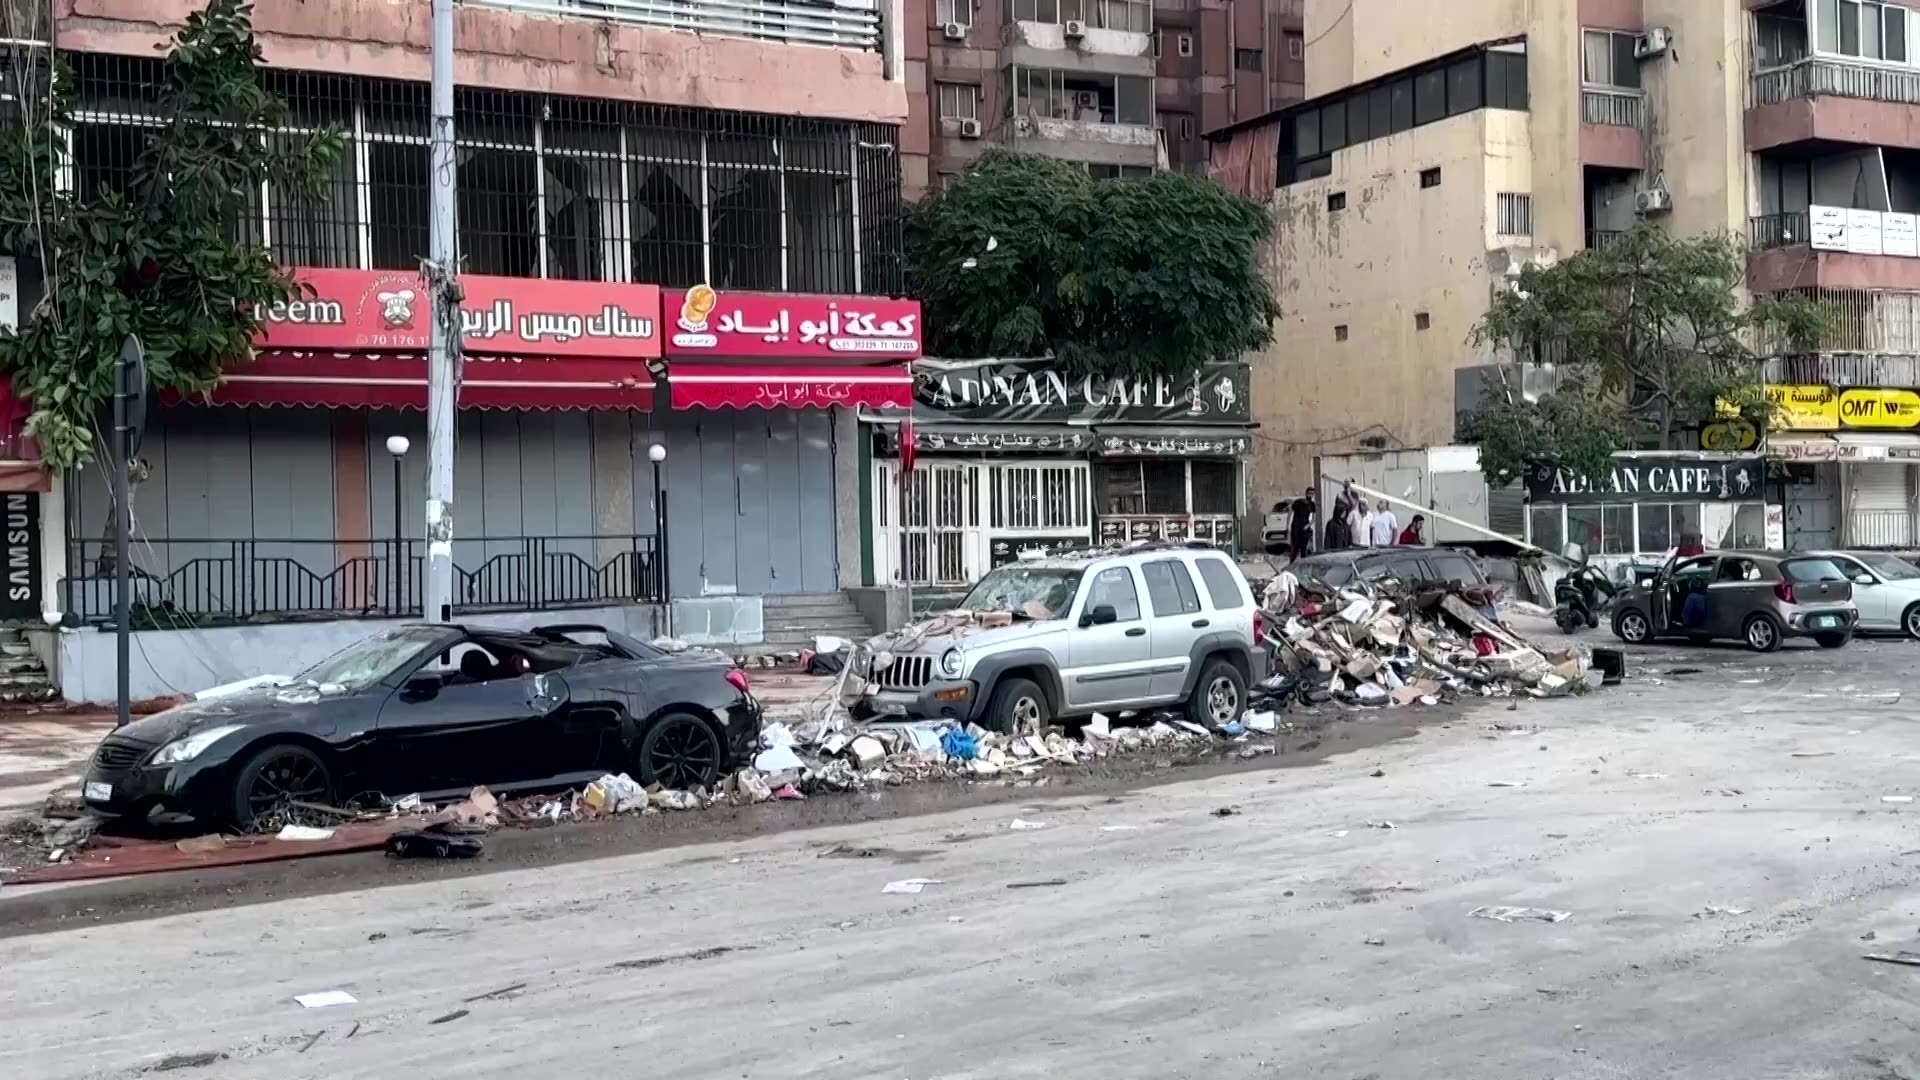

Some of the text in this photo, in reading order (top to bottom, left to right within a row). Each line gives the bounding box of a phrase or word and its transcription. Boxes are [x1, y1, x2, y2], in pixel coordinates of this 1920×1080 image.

[520, 313, 582, 341] ميس
[586, 305, 652, 337] سناك
[716, 302, 917, 344] كعكة أبو إياد
[372, 334, 387, 345] 70
[392, 335, 414, 345] 176
[932, 369, 1068, 408] ADNAN
[1083, 370, 1176, 408] CAFE
[1842, 399, 1878, 417] OMT
[993, 432, 1033, 449] عدنان
[1648, 466, 1712, 493] CAFE
[7, 494, 31, 601] SAMSUN
